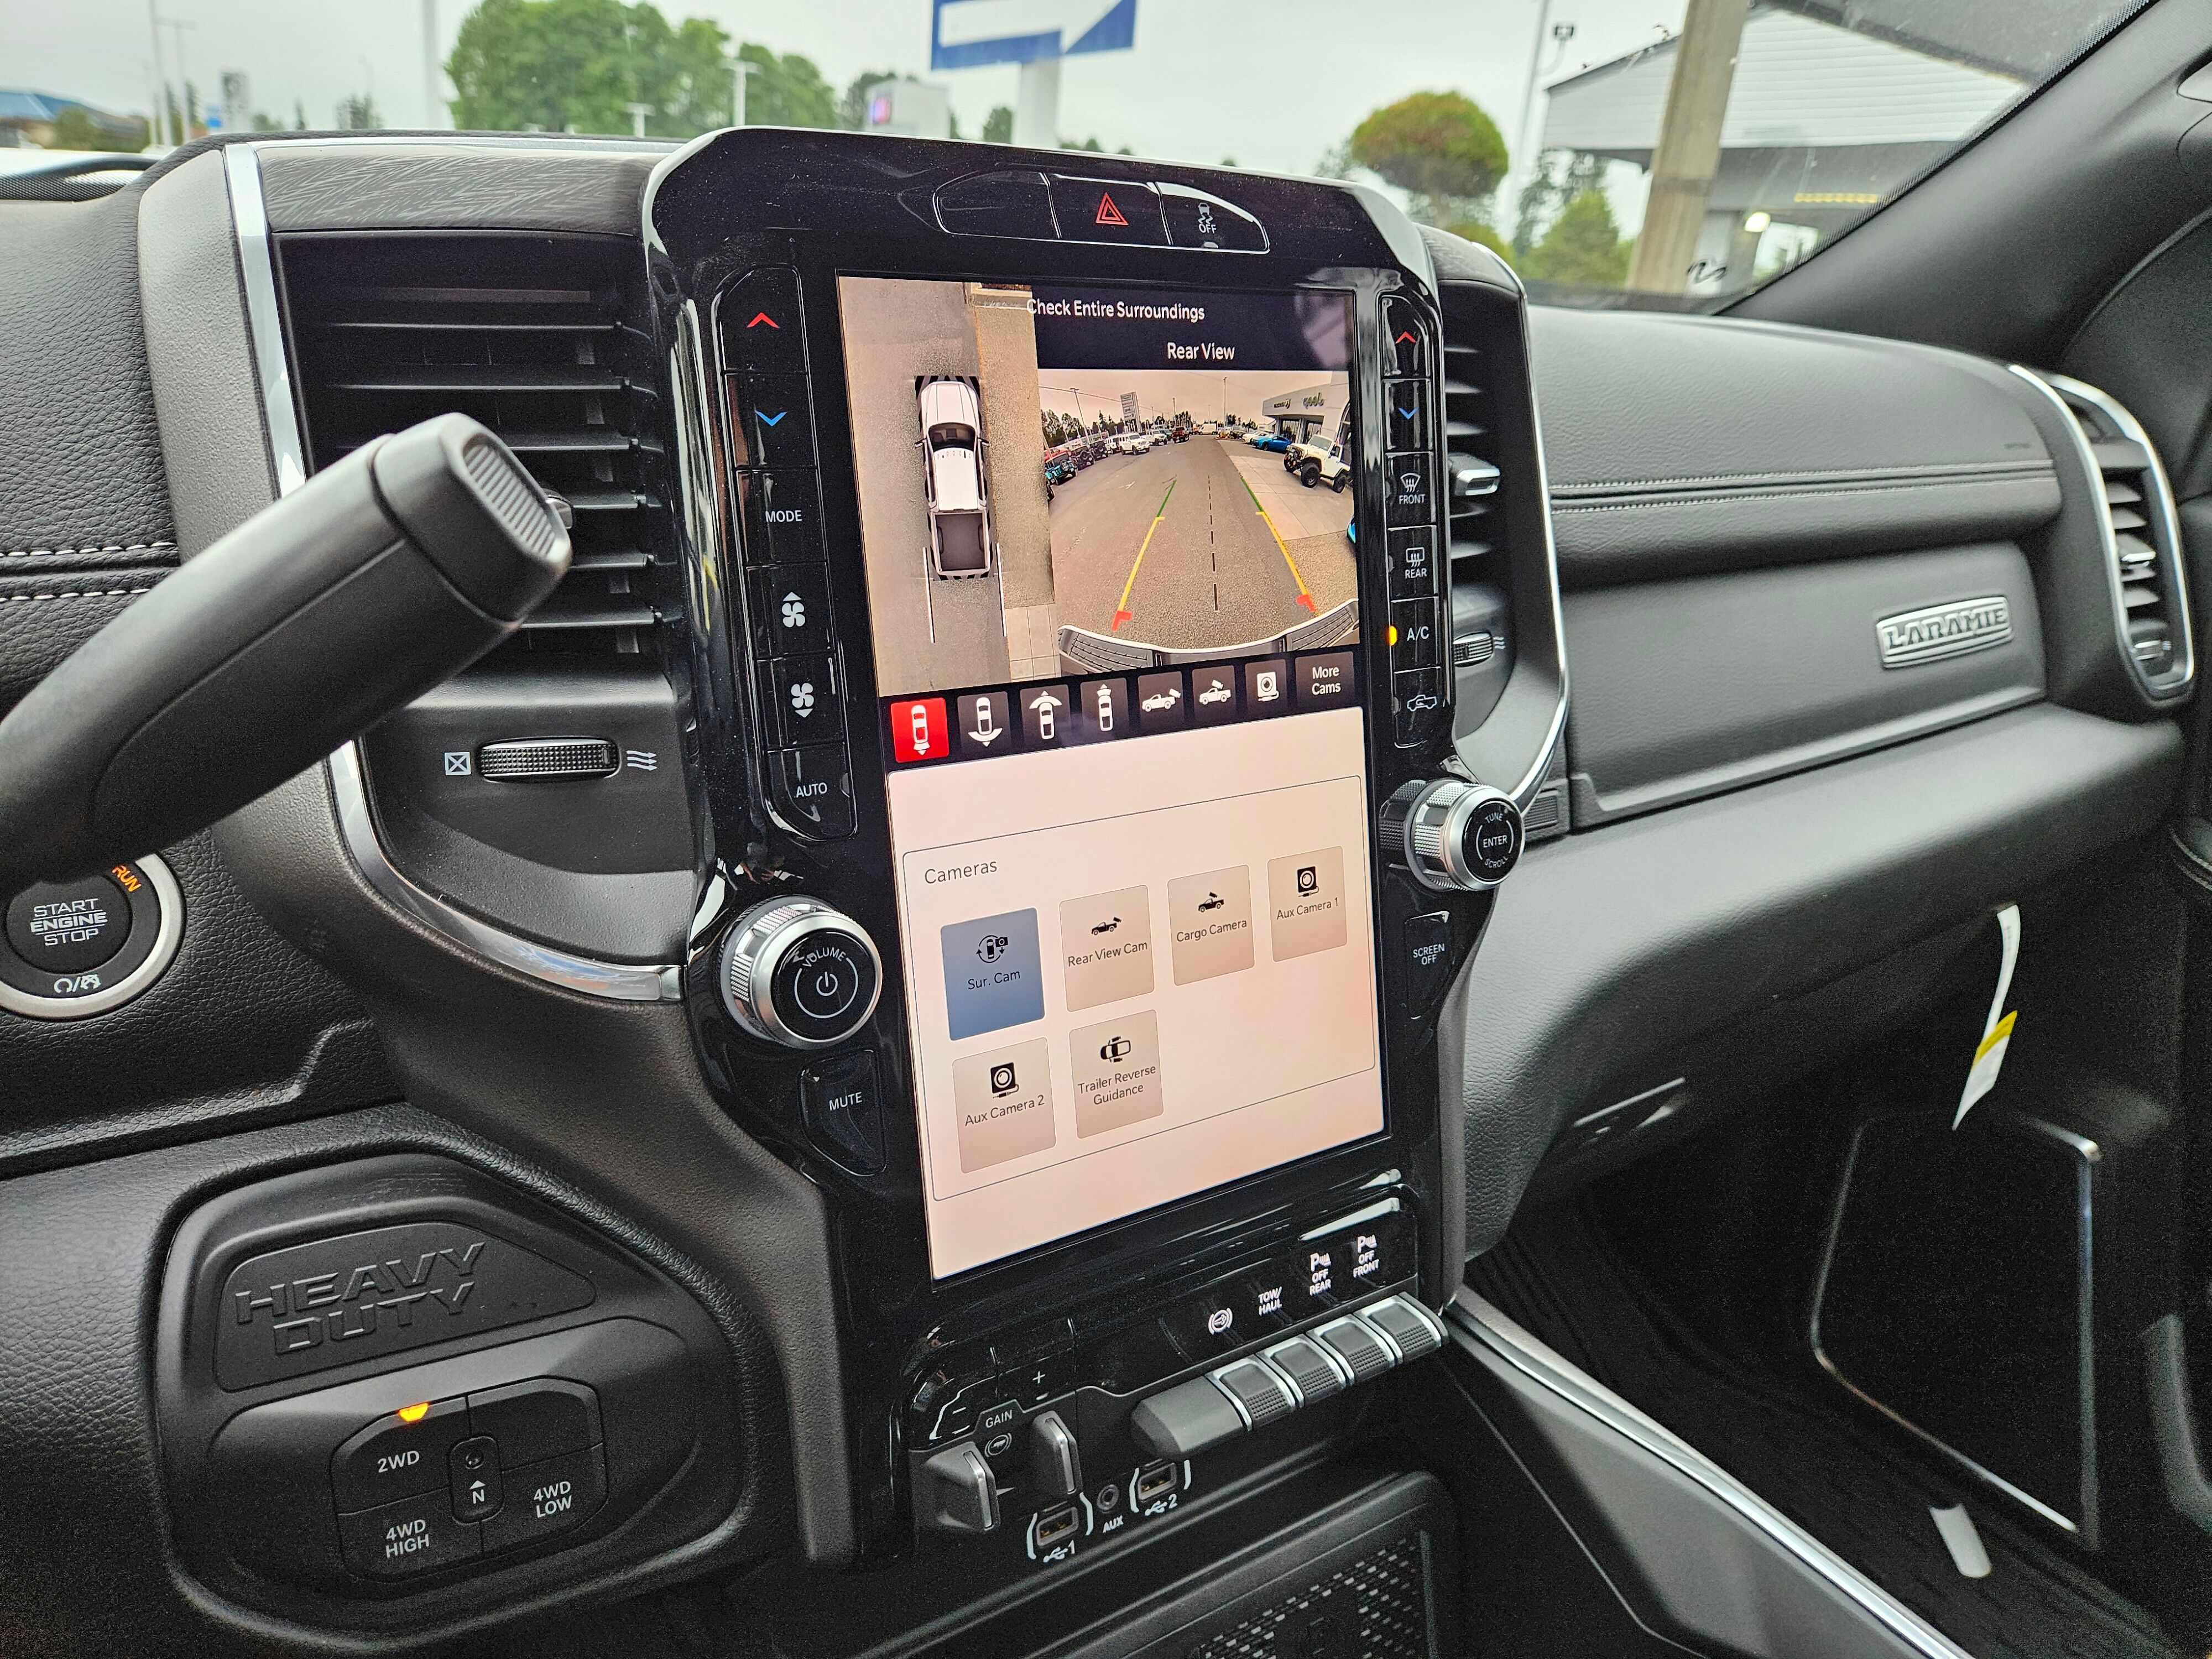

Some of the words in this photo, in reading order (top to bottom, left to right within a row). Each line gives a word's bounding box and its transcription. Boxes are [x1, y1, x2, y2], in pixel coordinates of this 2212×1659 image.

[1198, 223, 1217, 234] OFF
[1027, 298, 1071, 316] Check
[1074, 300, 1114, 317] Entire
[1117, 301, 1205, 322] Surroundings
[1167, 342, 1199, 360] Rear
[1201, 343, 1235, 361] View
[1399, 493, 1426, 505] FRONT
[765, 510, 802, 523] MODE
[1405, 567, 1427, 578] REAR
[1406, 627, 1430, 642] A/C
[1312, 666, 1339, 679] More
[1312, 682, 1341, 695] Cams
[796, 782, 827, 798] AUTO
[1484, 812, 1503, 825] TUNE
[1483, 834, 1507, 848] ENTER
[924, 859, 998, 884] Cameras
[1484, 855, 1509, 869] SCROLL
[112, 865, 142, 892] RUN
[33, 898, 100, 918] START
[1276, 909, 1295, 920] Aux
[1296, 901, 1332, 916] Camera
[1334, 897, 1338, 907] 1
[30, 912, 108, 933] ENGINE
[1176, 927, 1207, 942] Cargo
[1209, 919, 1248, 935] Camera
[44, 928, 98, 946] STOP
[802, 946, 847, 968] VOLUME
[1067, 953, 1093, 967] Rear
[1094, 946, 1122, 962] View
[1123, 940, 1148, 954] Cam
[1413, 943, 1445, 958] SCREEN
[1421, 954, 1437, 966] OFF
[967, 975, 992, 990] Sur.
[994, 968, 1021, 984] Cam
[1078, 1077, 1112, 1094] Trailer
[1114, 1065, 1156, 1084] Reverse
[830, 1092, 863, 1111] MUTE
[1093, 1084, 1144, 1105] Guidance
[964, 1111, 988, 1126] Aux
[990, 1099, 1035, 1119] Camera
[1036, 1094, 1045, 1105] 2
[1358, 1250, 1375, 1265] OFF
[1312, 1268, 1329, 1284] OFF
[1353, 1259, 1380, 1279] FRONT
[235, 1241, 487, 1324] HEAVY
[1310, 1279, 1332, 1296] REAR
[1258, 1286, 1282, 1304] TOW/
[1259, 1298, 1282, 1316] HAUL
[273, 1280, 476, 1355] DUTY
[985, 1410, 1013, 1428] GAIN
[377, 1451, 420, 1473] 2WD
[472, 1489, 485, 1504] N
[533, 1481, 571, 1501] 4WD
[536, 1495, 572, 1518] LOW
[386, 1519, 426, 1541] 4WD
[1103, 1515, 1124, 1533] AUX
[385, 1534, 430, 1558] HIGH
